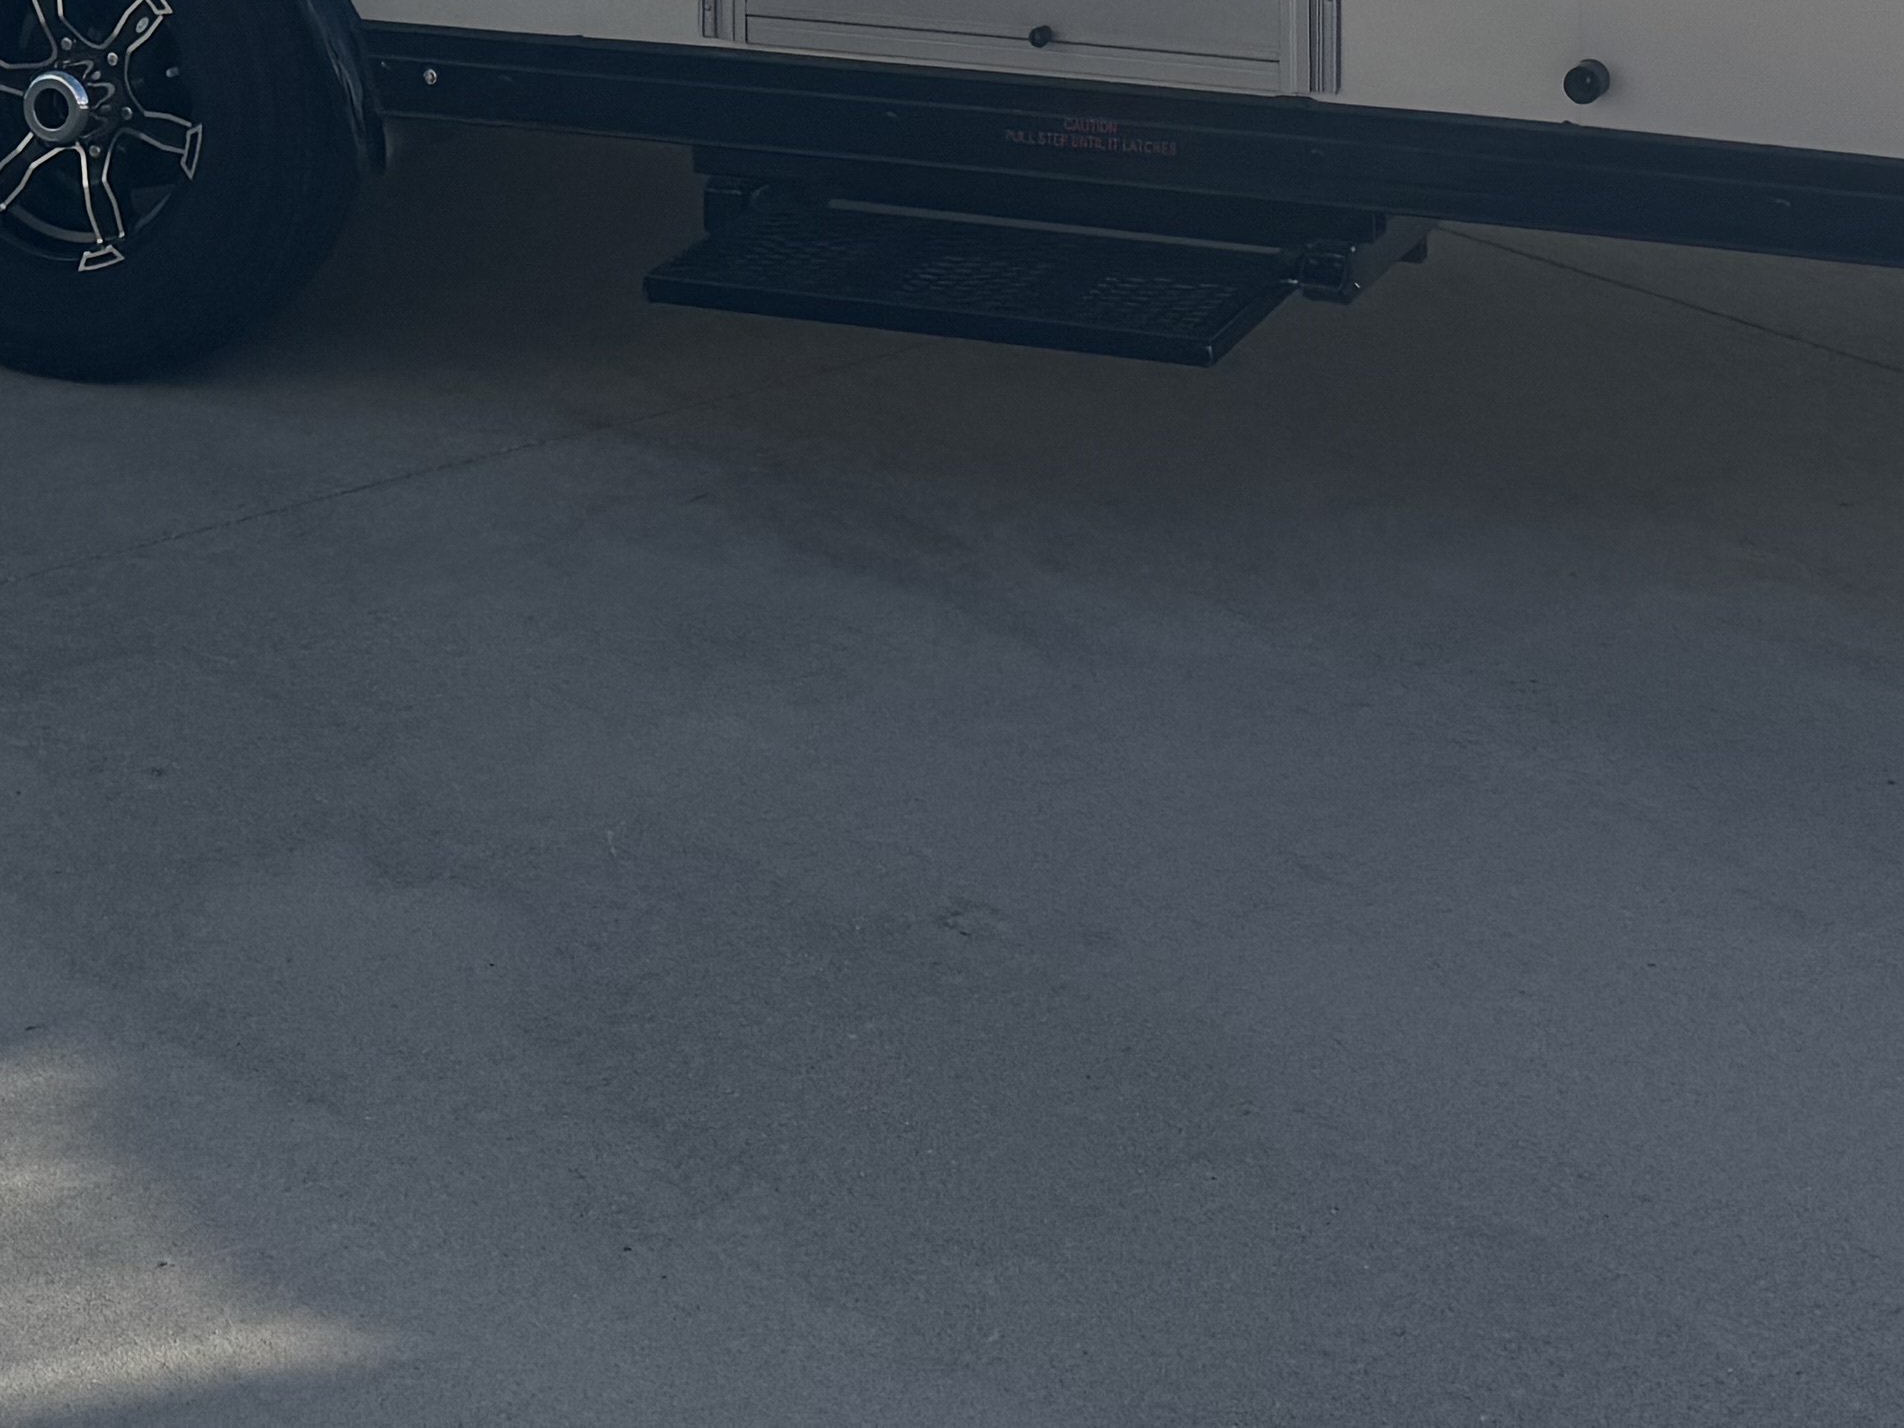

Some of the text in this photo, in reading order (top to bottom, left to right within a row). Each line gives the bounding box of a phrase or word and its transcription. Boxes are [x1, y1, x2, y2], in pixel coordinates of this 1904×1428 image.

[1063, 118, 1118, 133] CAUTION
[1005, 129, 1177, 156] PULL STEP UNTIL IT LATCHES
